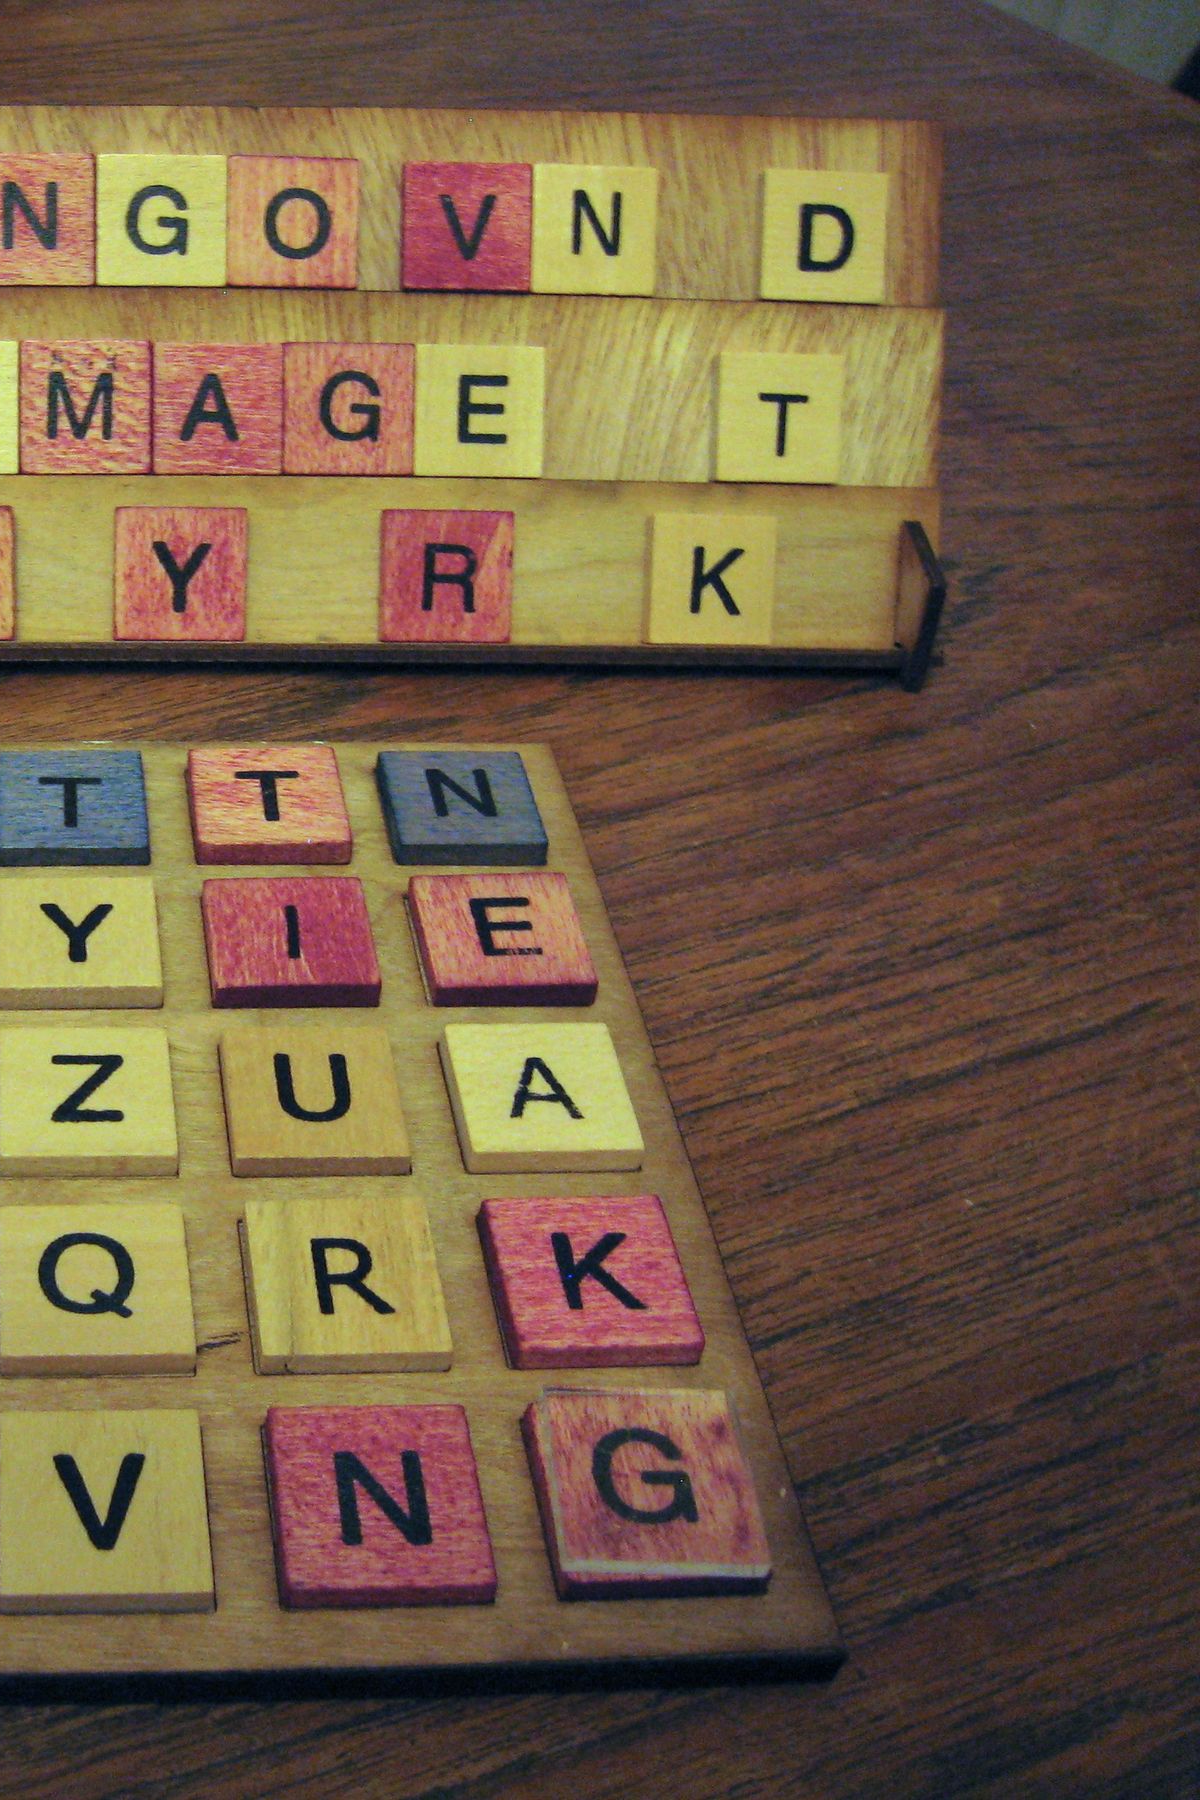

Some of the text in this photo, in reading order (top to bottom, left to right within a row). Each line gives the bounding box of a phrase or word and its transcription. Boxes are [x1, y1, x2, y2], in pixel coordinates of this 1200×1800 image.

[799, 202, 854, 273] D
[759, 392, 808, 457] T
[153, 541, 212, 614] Y
[423, 545, 476, 613] R
[690, 547, 740, 615] K
[39, 778, 101, 828] T
[235, 770, 299, 822] T
[427, 768, 498, 818] N
[40, 902, 113, 962] Y
[286, 905, 299, 959] I
[471, 897, 543, 957] E
[51, 1054, 125, 1122] Z
[273, 1053, 352, 1123] U
[510, 1057, 583, 1120] A
[38, 1233, 135, 1318] Q
[311, 1238, 396, 1315] R
[550, 1231, 648, 1310] K
[51, 1452, 145, 1552] V
[334, 1449, 432, 1545] N
[591, 1428, 698, 1525] G
